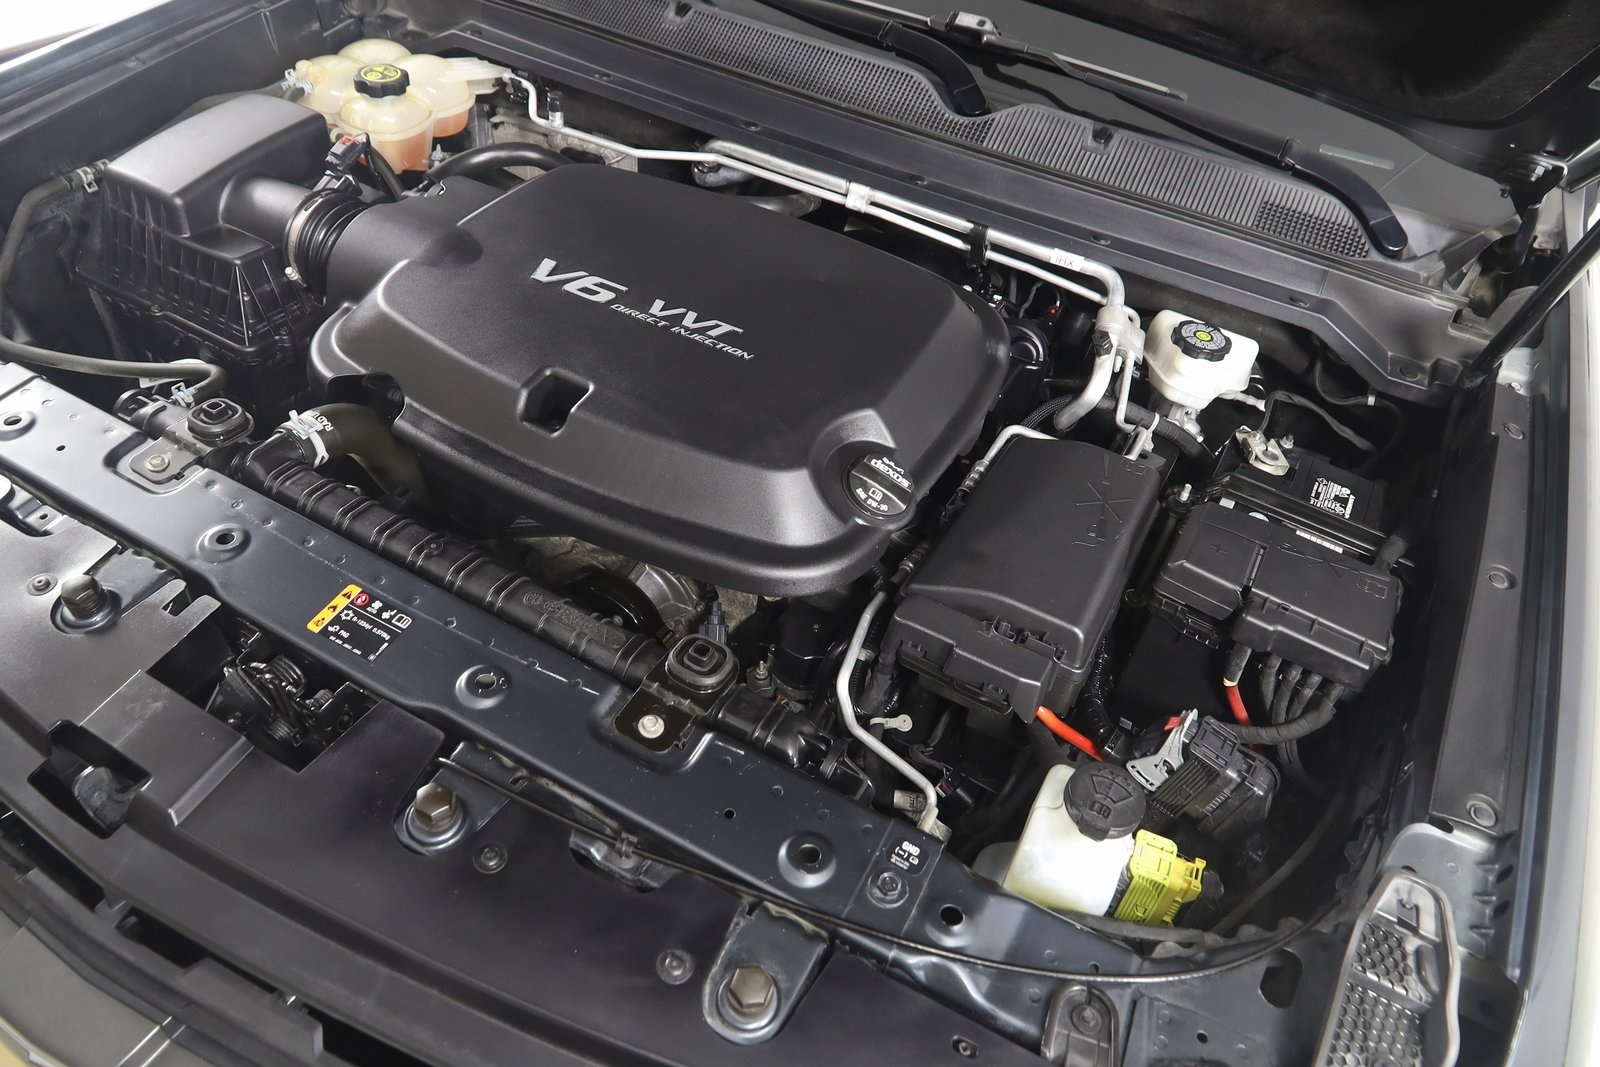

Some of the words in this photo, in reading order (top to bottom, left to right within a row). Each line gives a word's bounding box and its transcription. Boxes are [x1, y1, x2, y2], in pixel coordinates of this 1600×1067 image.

[530, 257, 629, 304] V6
[610, 303, 669, 327] DIRECT
[670, 326, 755, 360] INJECTION
[648, 299, 745, 338] VVT
[317, 415, 334, 432] RAD
[870, 458, 911, 488] dexos
[901, 841, 920, 856] GND
